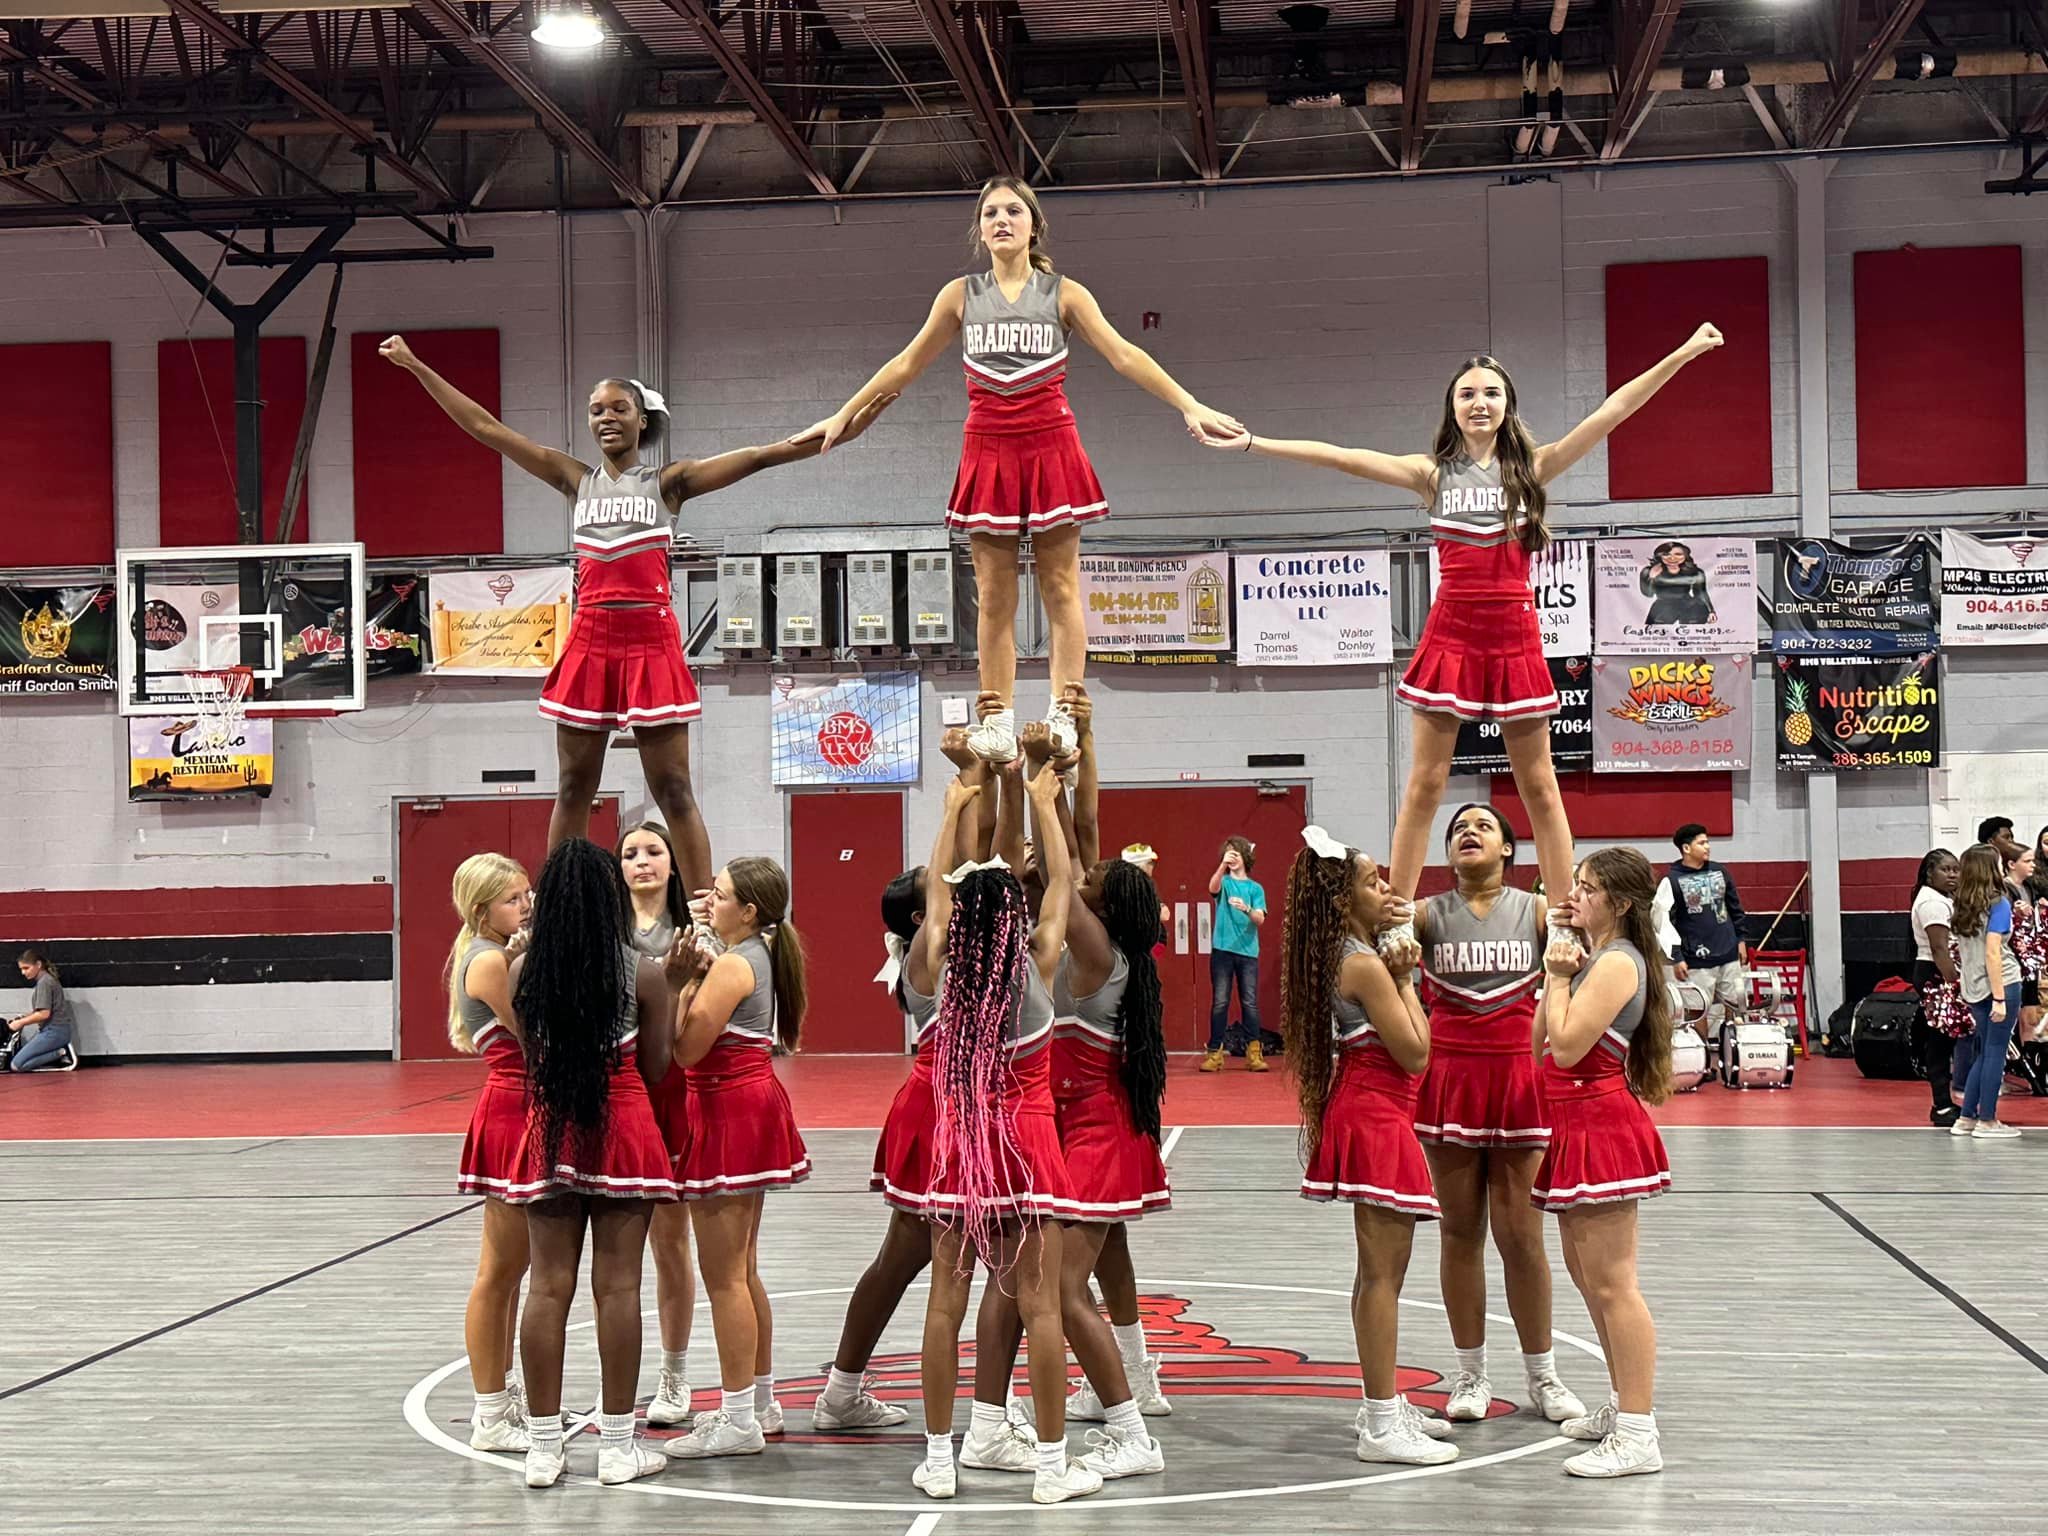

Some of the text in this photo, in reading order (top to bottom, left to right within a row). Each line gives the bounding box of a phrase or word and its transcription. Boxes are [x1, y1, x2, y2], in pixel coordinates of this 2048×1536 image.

[966, 323, 1053, 354] BRADFORD
[1080, 560, 1187, 573] AAA BAIL BONDING AGENCY
[1258, 555, 1366, 577] Concrete
[1943, 569, 1982, 582] MP46
[1243, 580, 1389, 601] Professionals.
[1831, 578, 1914, 594] GARAGE
[1298, 605, 1329, 620] LLC
[1776, 603, 1930, 617] COMPLETE AUTO REPAIR
[1548, 612, 1569, 627] Spa
[1260, 631, 1290, 641] Darrel
[1340, 628, 1374, 639] Walter
[1255, 643, 1298, 654] Thomas
[1338, 641, 1375, 652] Donley
[1781, 638, 1872, 650] 904-782-3232
[56, 663, 104, 675] County
[25, 680, 74, 692] Gordon
[78, 679, 117, 691] Smith
[1629, 683, 1713, 707] WINGS
[1661, 703, 1694, 719] GRILL
[823, 719, 867, 734] BMS
[1834, 709, 1930, 744] Escape
[1612, 740, 1735, 756] 904-368-8158
[183, 755, 228, 764] MEXICAN
[1832, 751, 1932, 766] 386-365-1509
[173, 764, 240, 775] RESTAURANT
[803, 763, 890, 776] SPONSORS
[1434, 940, 1532, 973] BRADFORD
